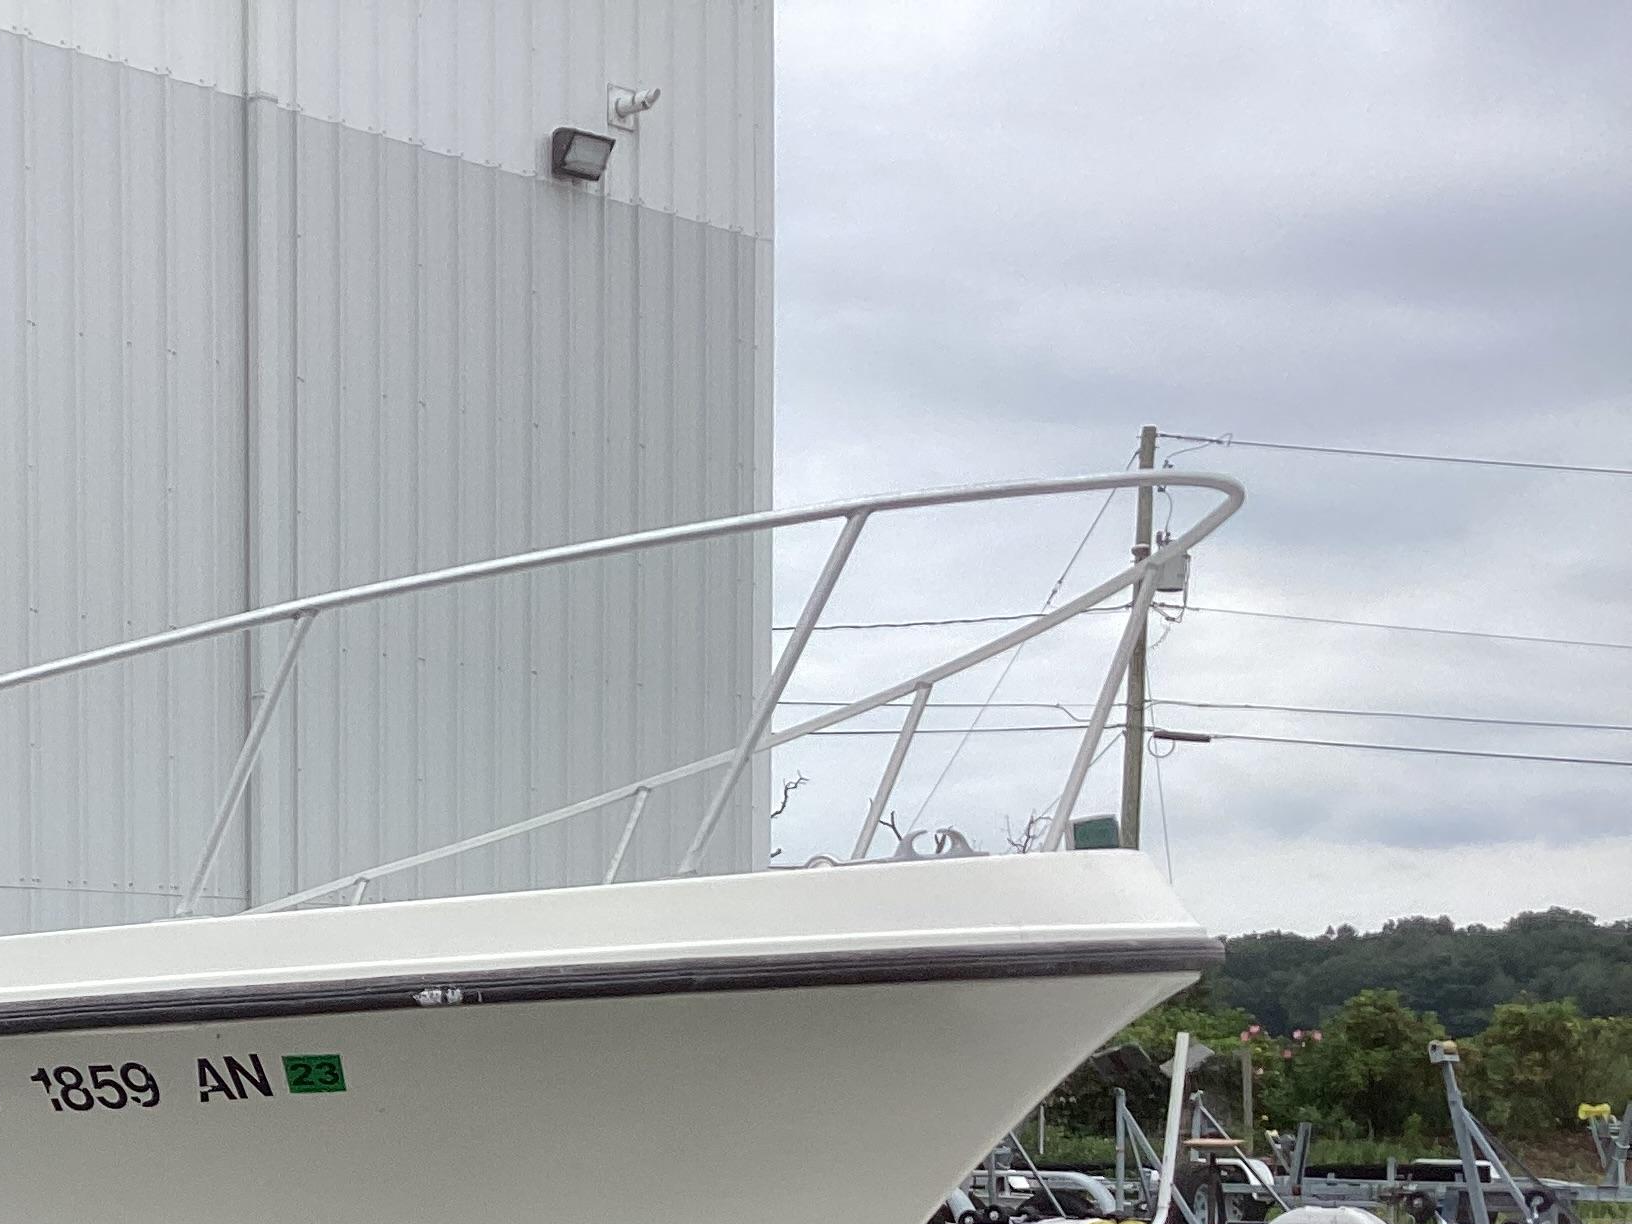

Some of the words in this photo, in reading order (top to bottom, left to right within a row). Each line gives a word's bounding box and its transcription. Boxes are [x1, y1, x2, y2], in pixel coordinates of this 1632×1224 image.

[30, 1061, 161, 1113] 1859
[196, 1053, 274, 1103] AN
[289, 1061, 342, 1088] 23
